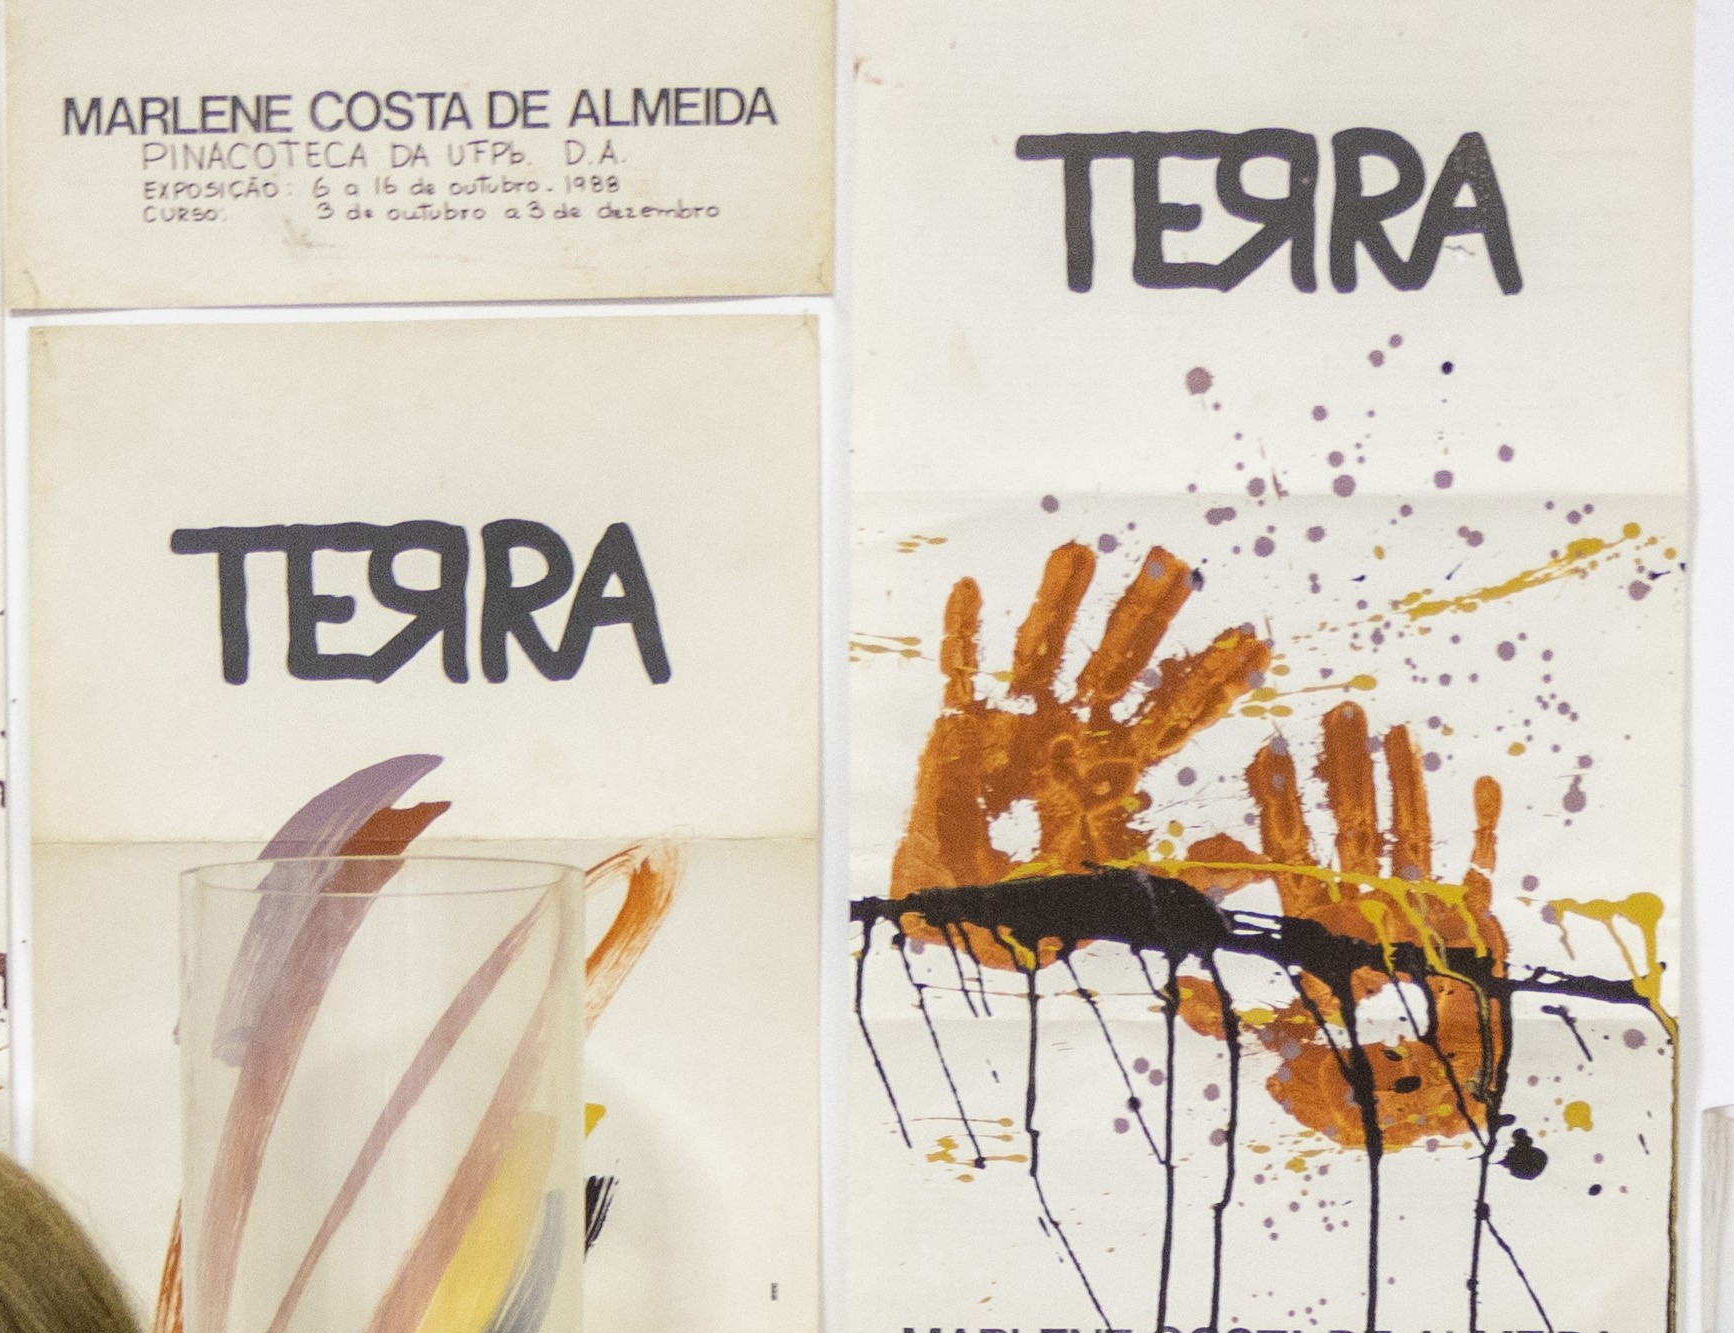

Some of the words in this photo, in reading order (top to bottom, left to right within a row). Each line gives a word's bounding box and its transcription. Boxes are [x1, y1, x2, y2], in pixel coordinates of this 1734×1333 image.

[63, 95, 293, 136] MARLENE
[309, 90, 473, 131] COSTA
[488, 89, 550, 129] DE
[568, 87, 779, 128] ALMEIDA
[141, 140, 368, 170] PINACOTECA
[390, 143, 429, 168] DA
[312, 177, 330, 198] 6
[344, 183, 359, 196] a
[374, 176, 397, 196] 16
[409, 177, 436, 196] de
[565, 174, 621, 194] 1988
[316, 202, 334, 221] 3
[346, 203, 373, 221] de
[386, 200, 485, 221] outubro
[528, 201, 545, 220] 3
[553, 201, 581, 220] de
[597, 198, 720, 220] dezembro
[1015, 127, 1523, 295] TERRA
[170, 519, 671, 685] TERRA
